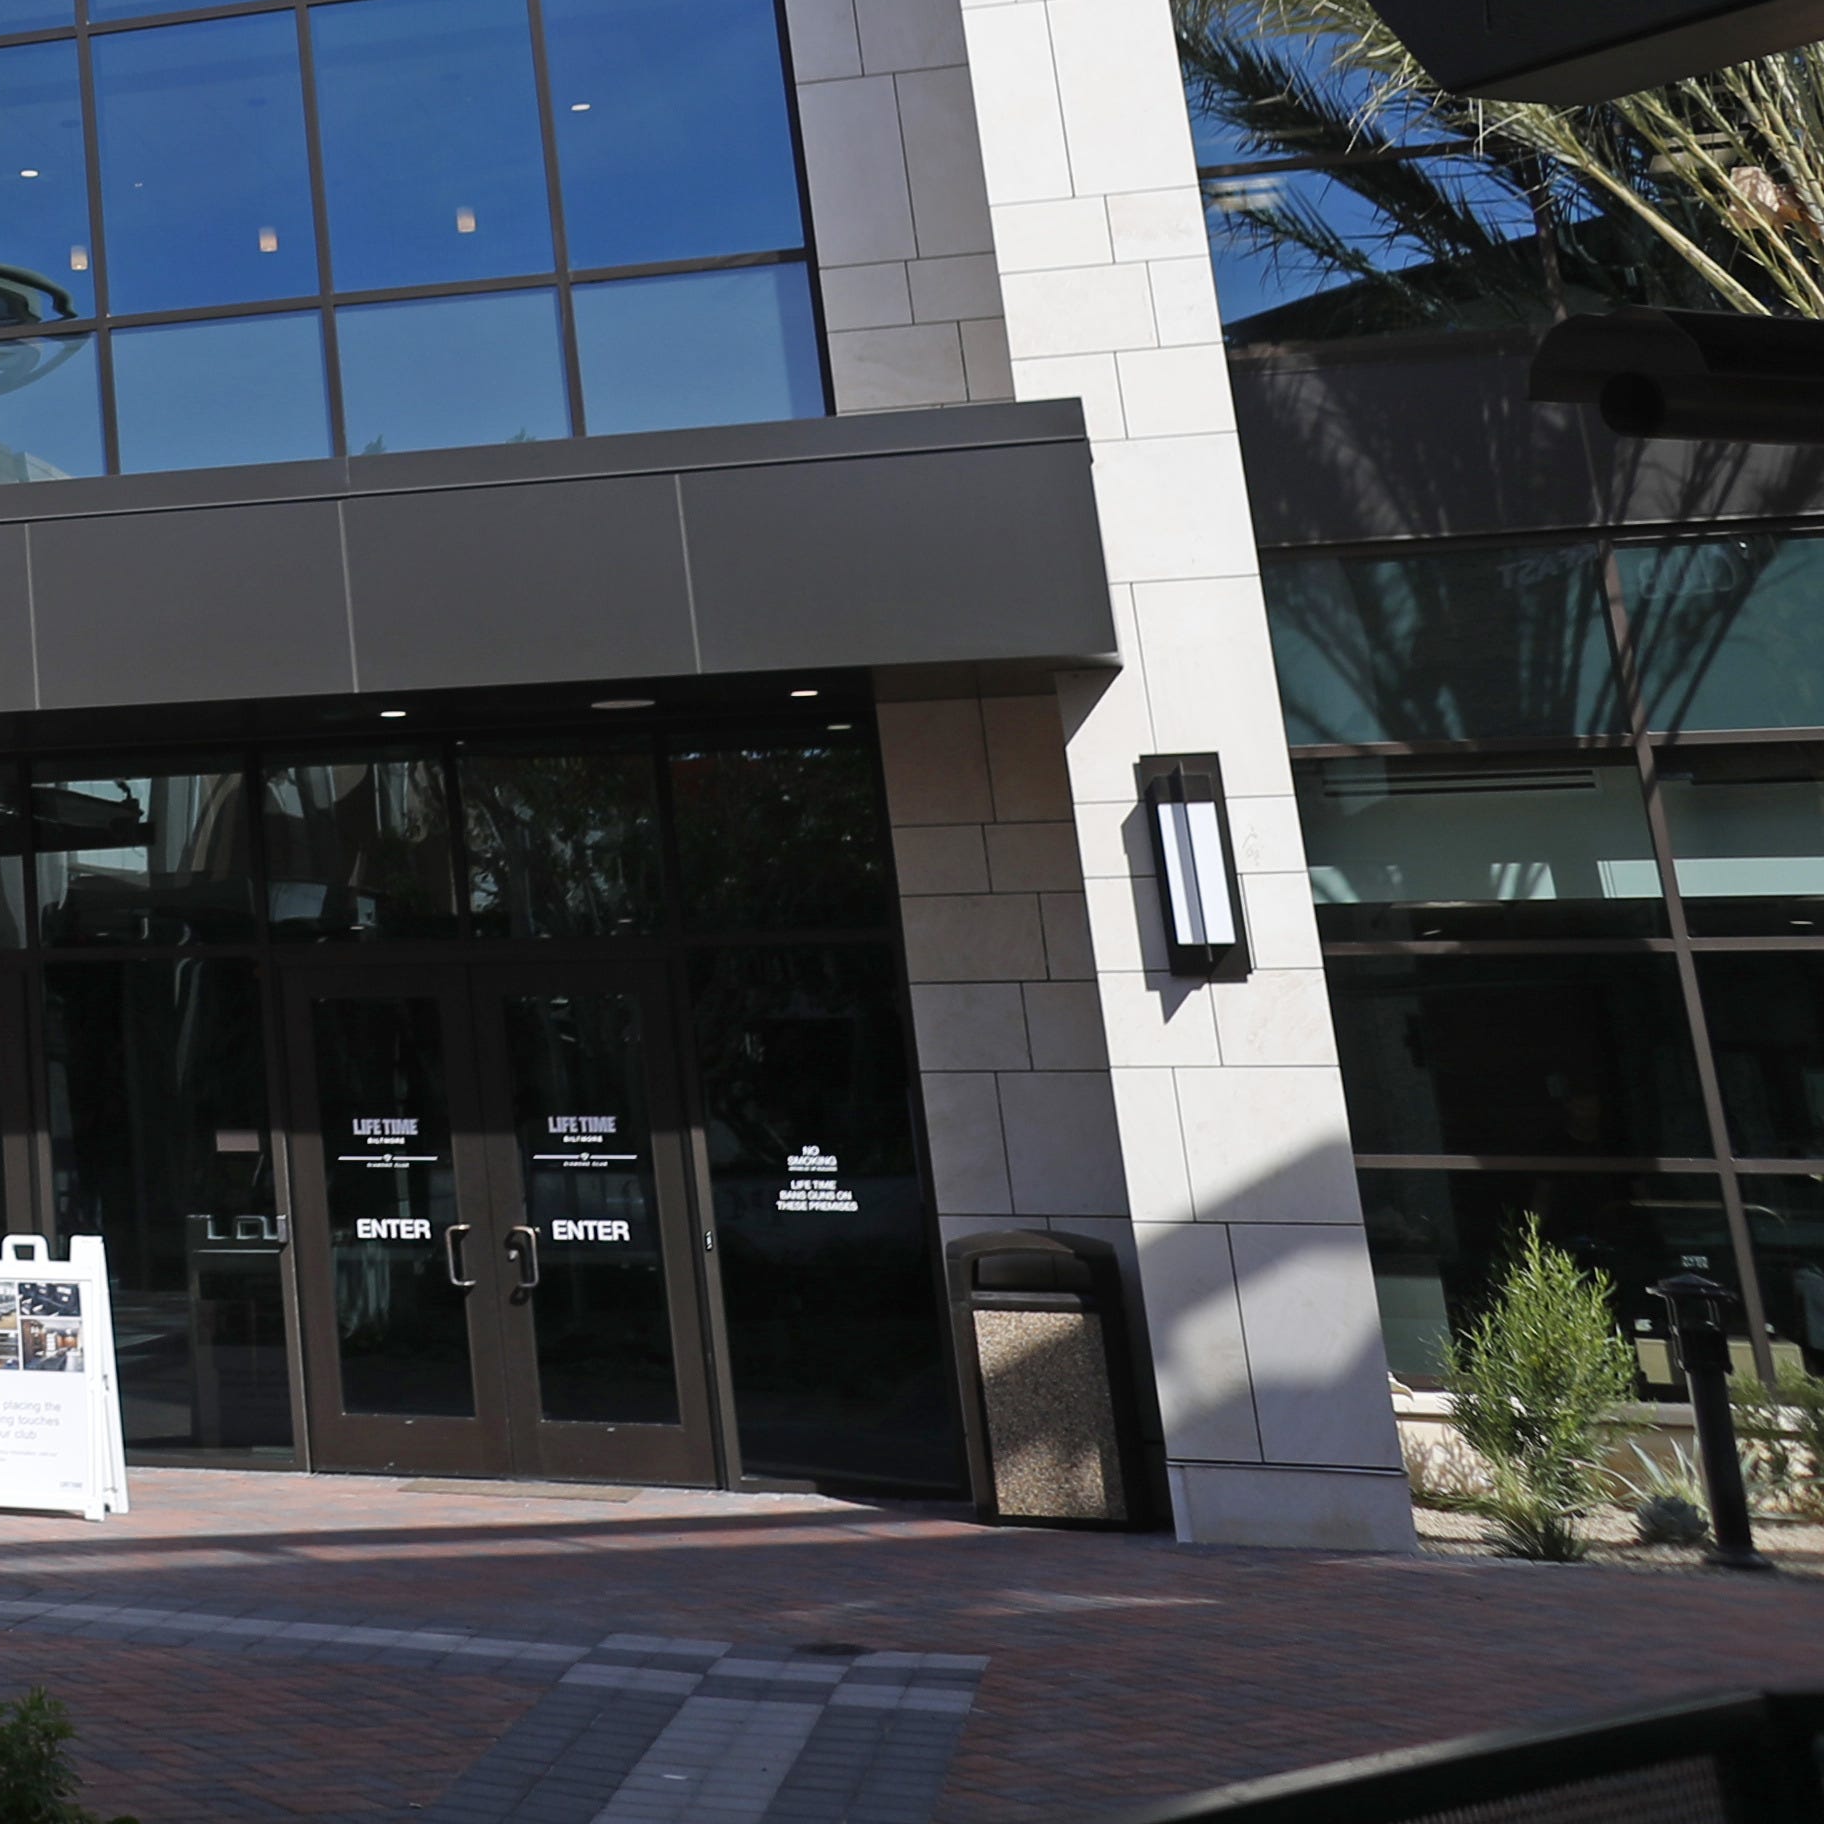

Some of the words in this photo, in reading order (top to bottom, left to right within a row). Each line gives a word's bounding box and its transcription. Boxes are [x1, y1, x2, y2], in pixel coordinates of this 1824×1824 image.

[352, 1118, 381, 1135] LIFE
[382, 1118, 419, 1135] TIME
[548, 1115, 578, 1133] LIFE
[579, 1115, 617, 1133] TIME
[802, 1145, 820, 1156] NO
[787, 1155, 838, 1166] SMOKING
[790, 1179, 812, 1191] LIFE
[812, 1179, 838, 1191] TIME
[779, 1190, 807, 1200] BANS
[807, 1190, 836, 1201] GUNS
[836, 1190, 853, 1201] ON
[776, 1201, 808, 1211] THESE
[808, 1201, 859, 1212] PREMISES
[356, 1218, 432, 1240] ENTER
[551, 1219, 631, 1242] ENTER
[2, 1400, 42, 1414] placing
[44, 1401, 62, 1412] the
[17, 1415, 61, 1427] touches
[14, 1430, 38, 1441] club
